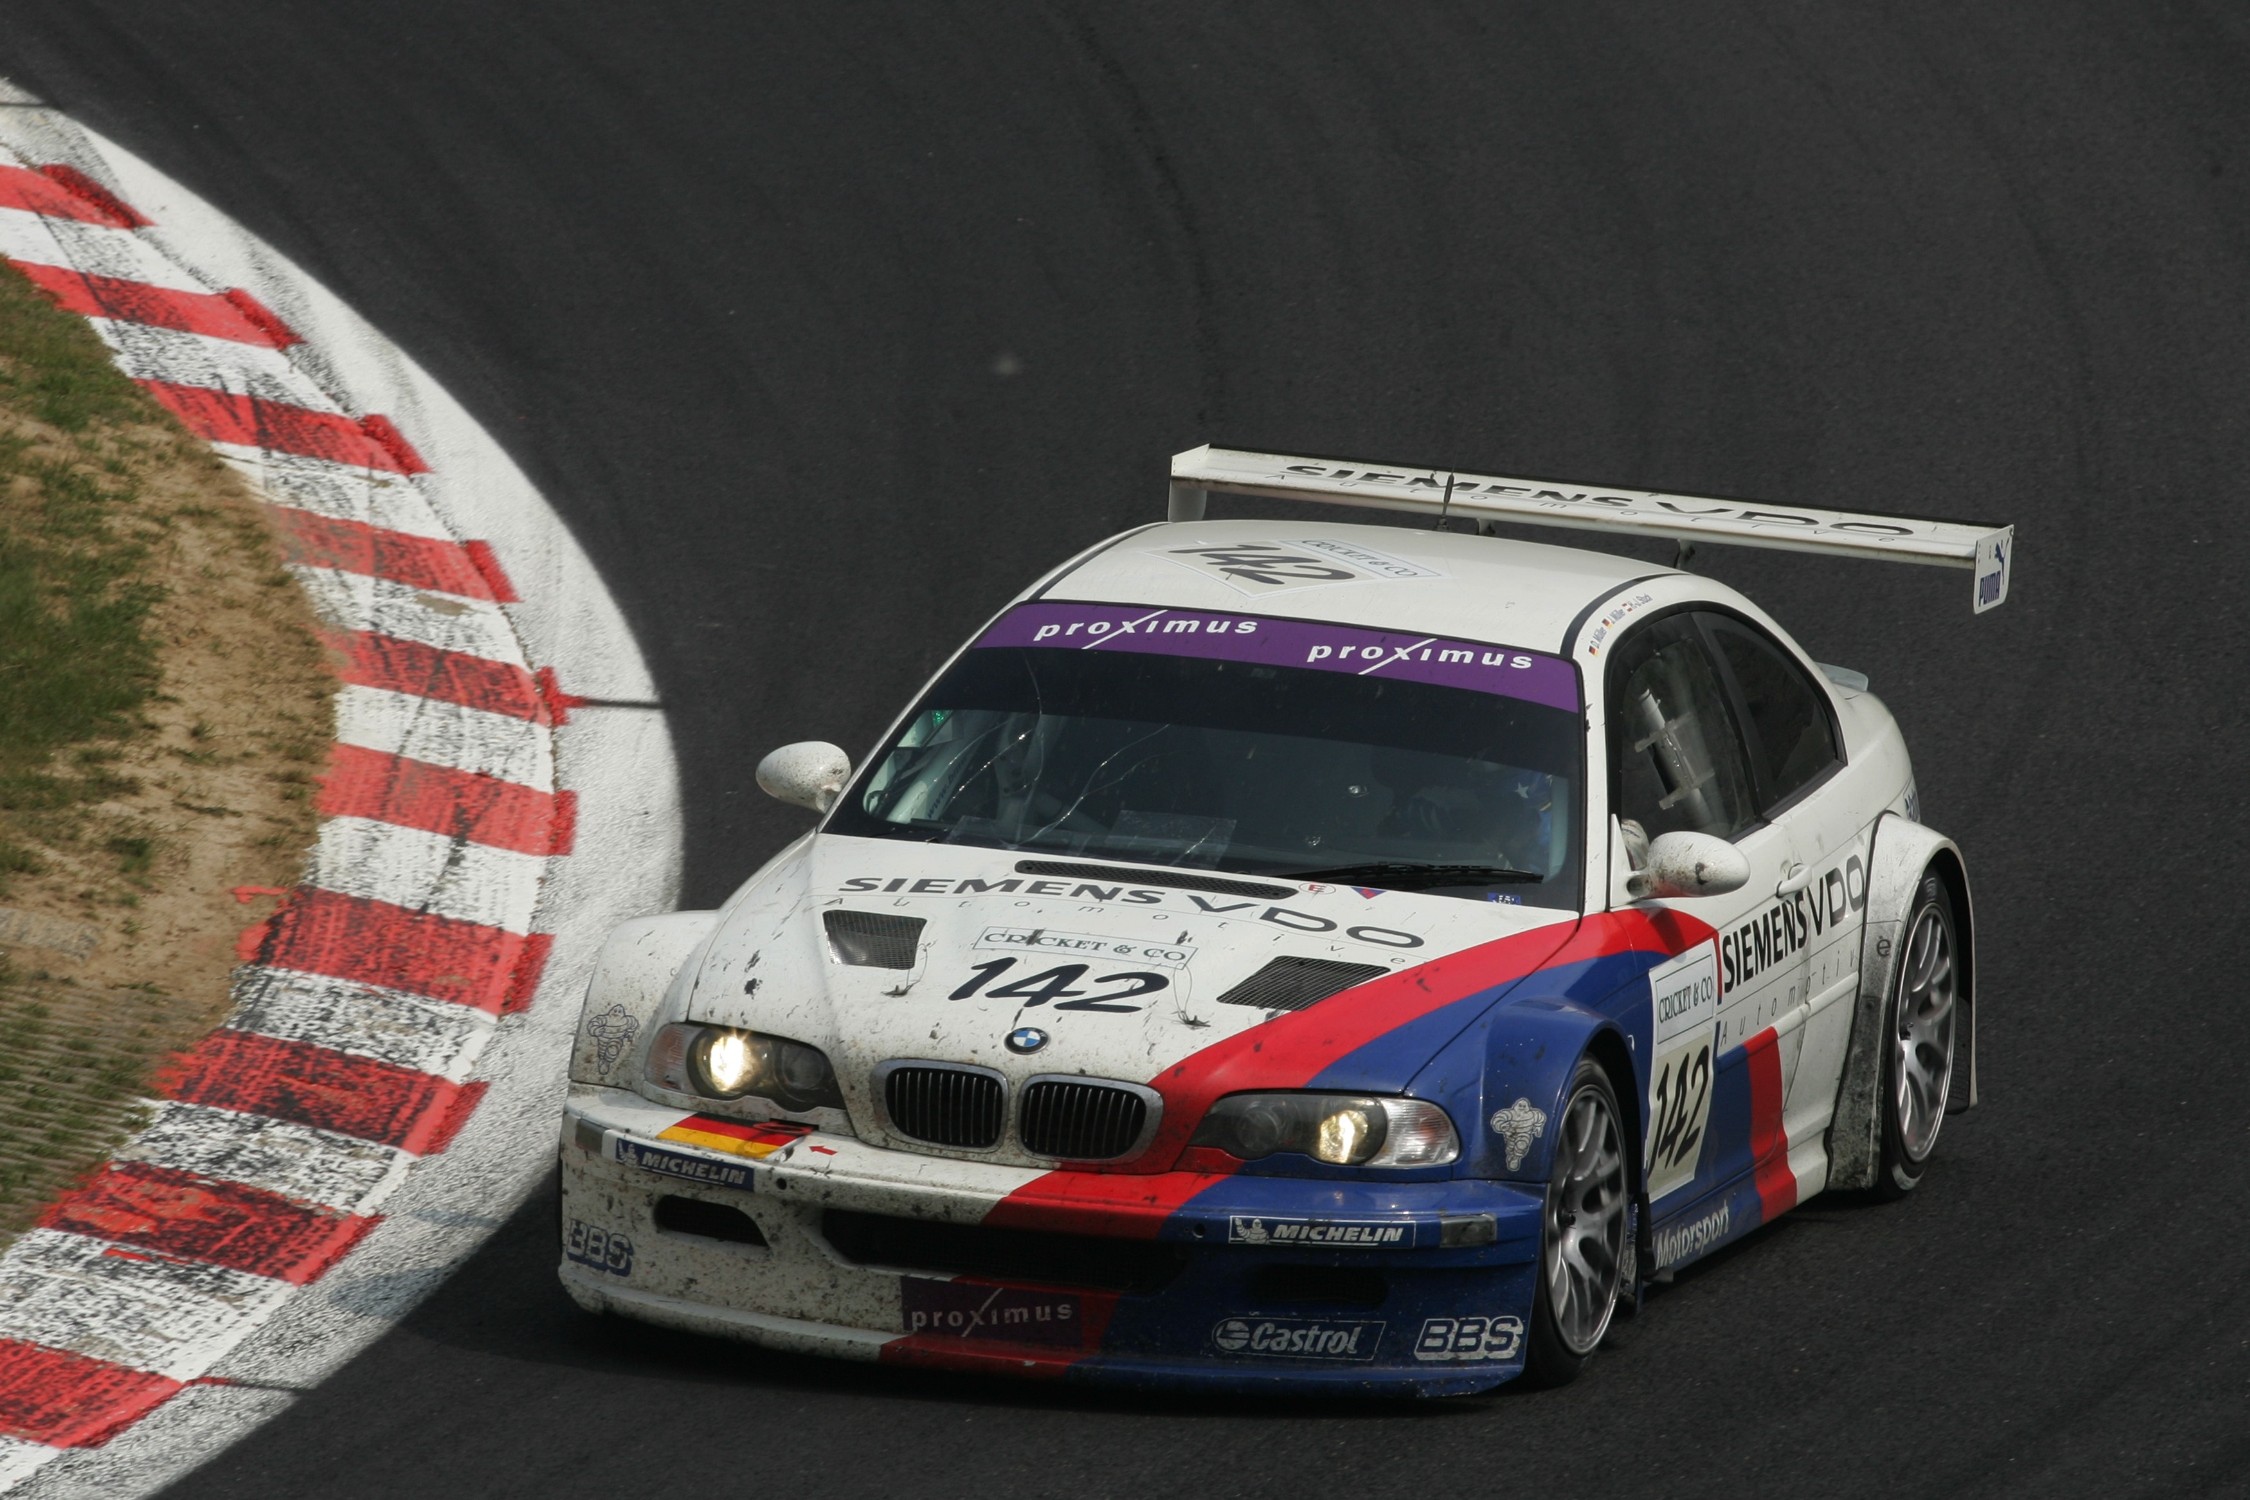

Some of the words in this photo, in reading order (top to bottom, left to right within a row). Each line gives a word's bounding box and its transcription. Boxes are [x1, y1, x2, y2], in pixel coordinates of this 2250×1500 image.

[1280, 465, 1633, 508] SIEMENS
[1656, 501, 1914, 536] VDO
[1168, 544, 1356, 585] 142
[1384, 565, 1418, 577] CO
[1033, 609, 1259, 650] proximus
[1307, 638, 1533, 675] proximus
[838, 877, 1166, 905] SIEMENS
[1187, 895, 1425, 948] VDO
[1722, 890, 1808, 994] SIEMENS
[1807, 854, 1865, 937] VDO
[984, 932, 1108, 952] CRCKET
[1113, 942, 1137, 955] &
[1143, 948, 1187, 961] CO
[948, 956, 1170, 1013] 142
[1658, 983, 1693, 1024] CRICKET
[1692, 984, 1700, 1005] &
[1701, 975, 1713, 1004] CO
[1648, 1044, 1710, 1176] 142
[641, 1150, 747, 1186] MICHELIN
[567, 1218, 634, 1278] BBS
[1272, 1222, 1404, 1244] MICHELIN
[1655, 1199, 1729, 1270] Motorsport
[910, 1287, 1074, 1338] proximus
[1250, 1320, 1362, 1355] Castrol
[1414, 1316, 1525, 1362] BBS
